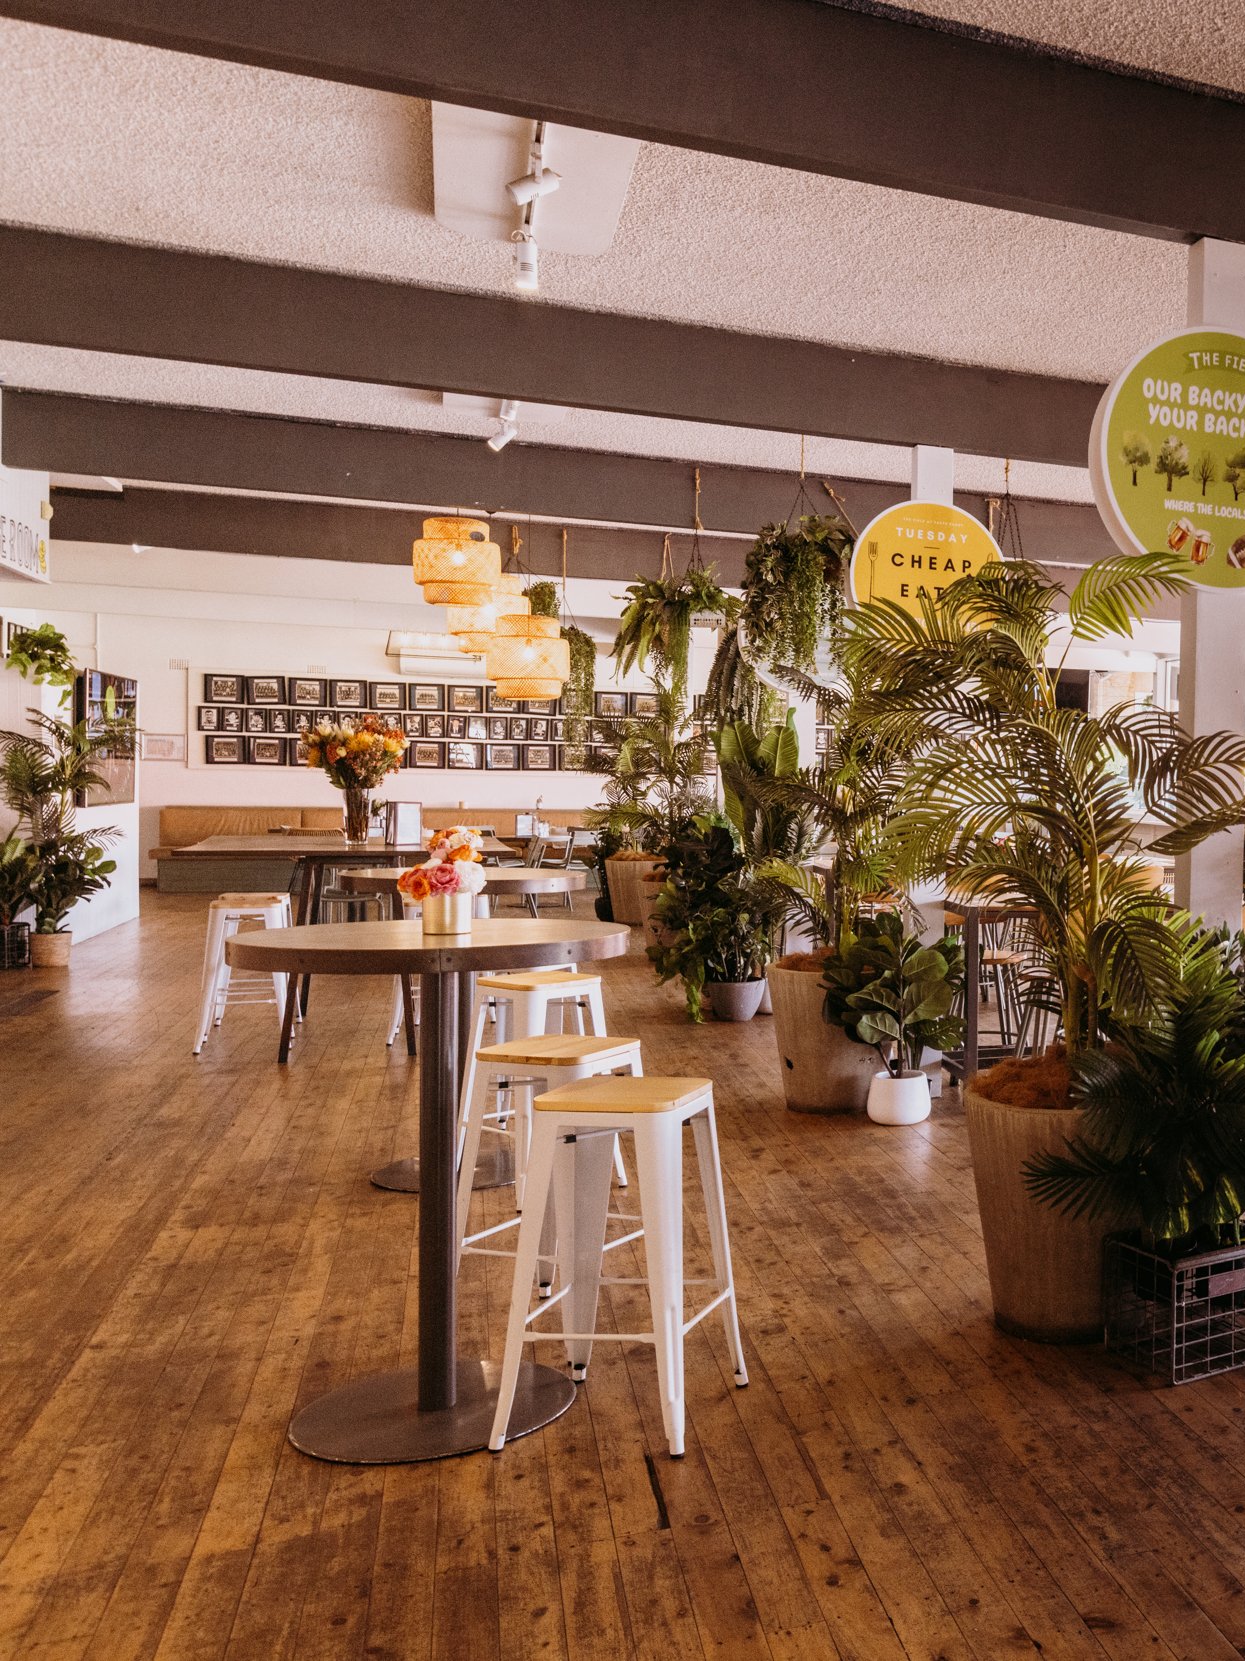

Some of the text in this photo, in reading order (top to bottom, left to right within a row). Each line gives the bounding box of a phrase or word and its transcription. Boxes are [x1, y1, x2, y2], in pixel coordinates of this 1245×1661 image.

[1188, 352, 1220, 369] THE
[1142, 377, 1182, 404] OUR
[1148, 402, 1198, 432] YOUR
[1164, 499, 1195, 513] WHERE
[1196, 503, 1213, 515] THE
[896, 526, 968, 544] TUESDAY
[9, 519, 39, 574] ROOM
[891, 552, 972, 573] CHEAP
[900, 583, 946, 600] EAT
